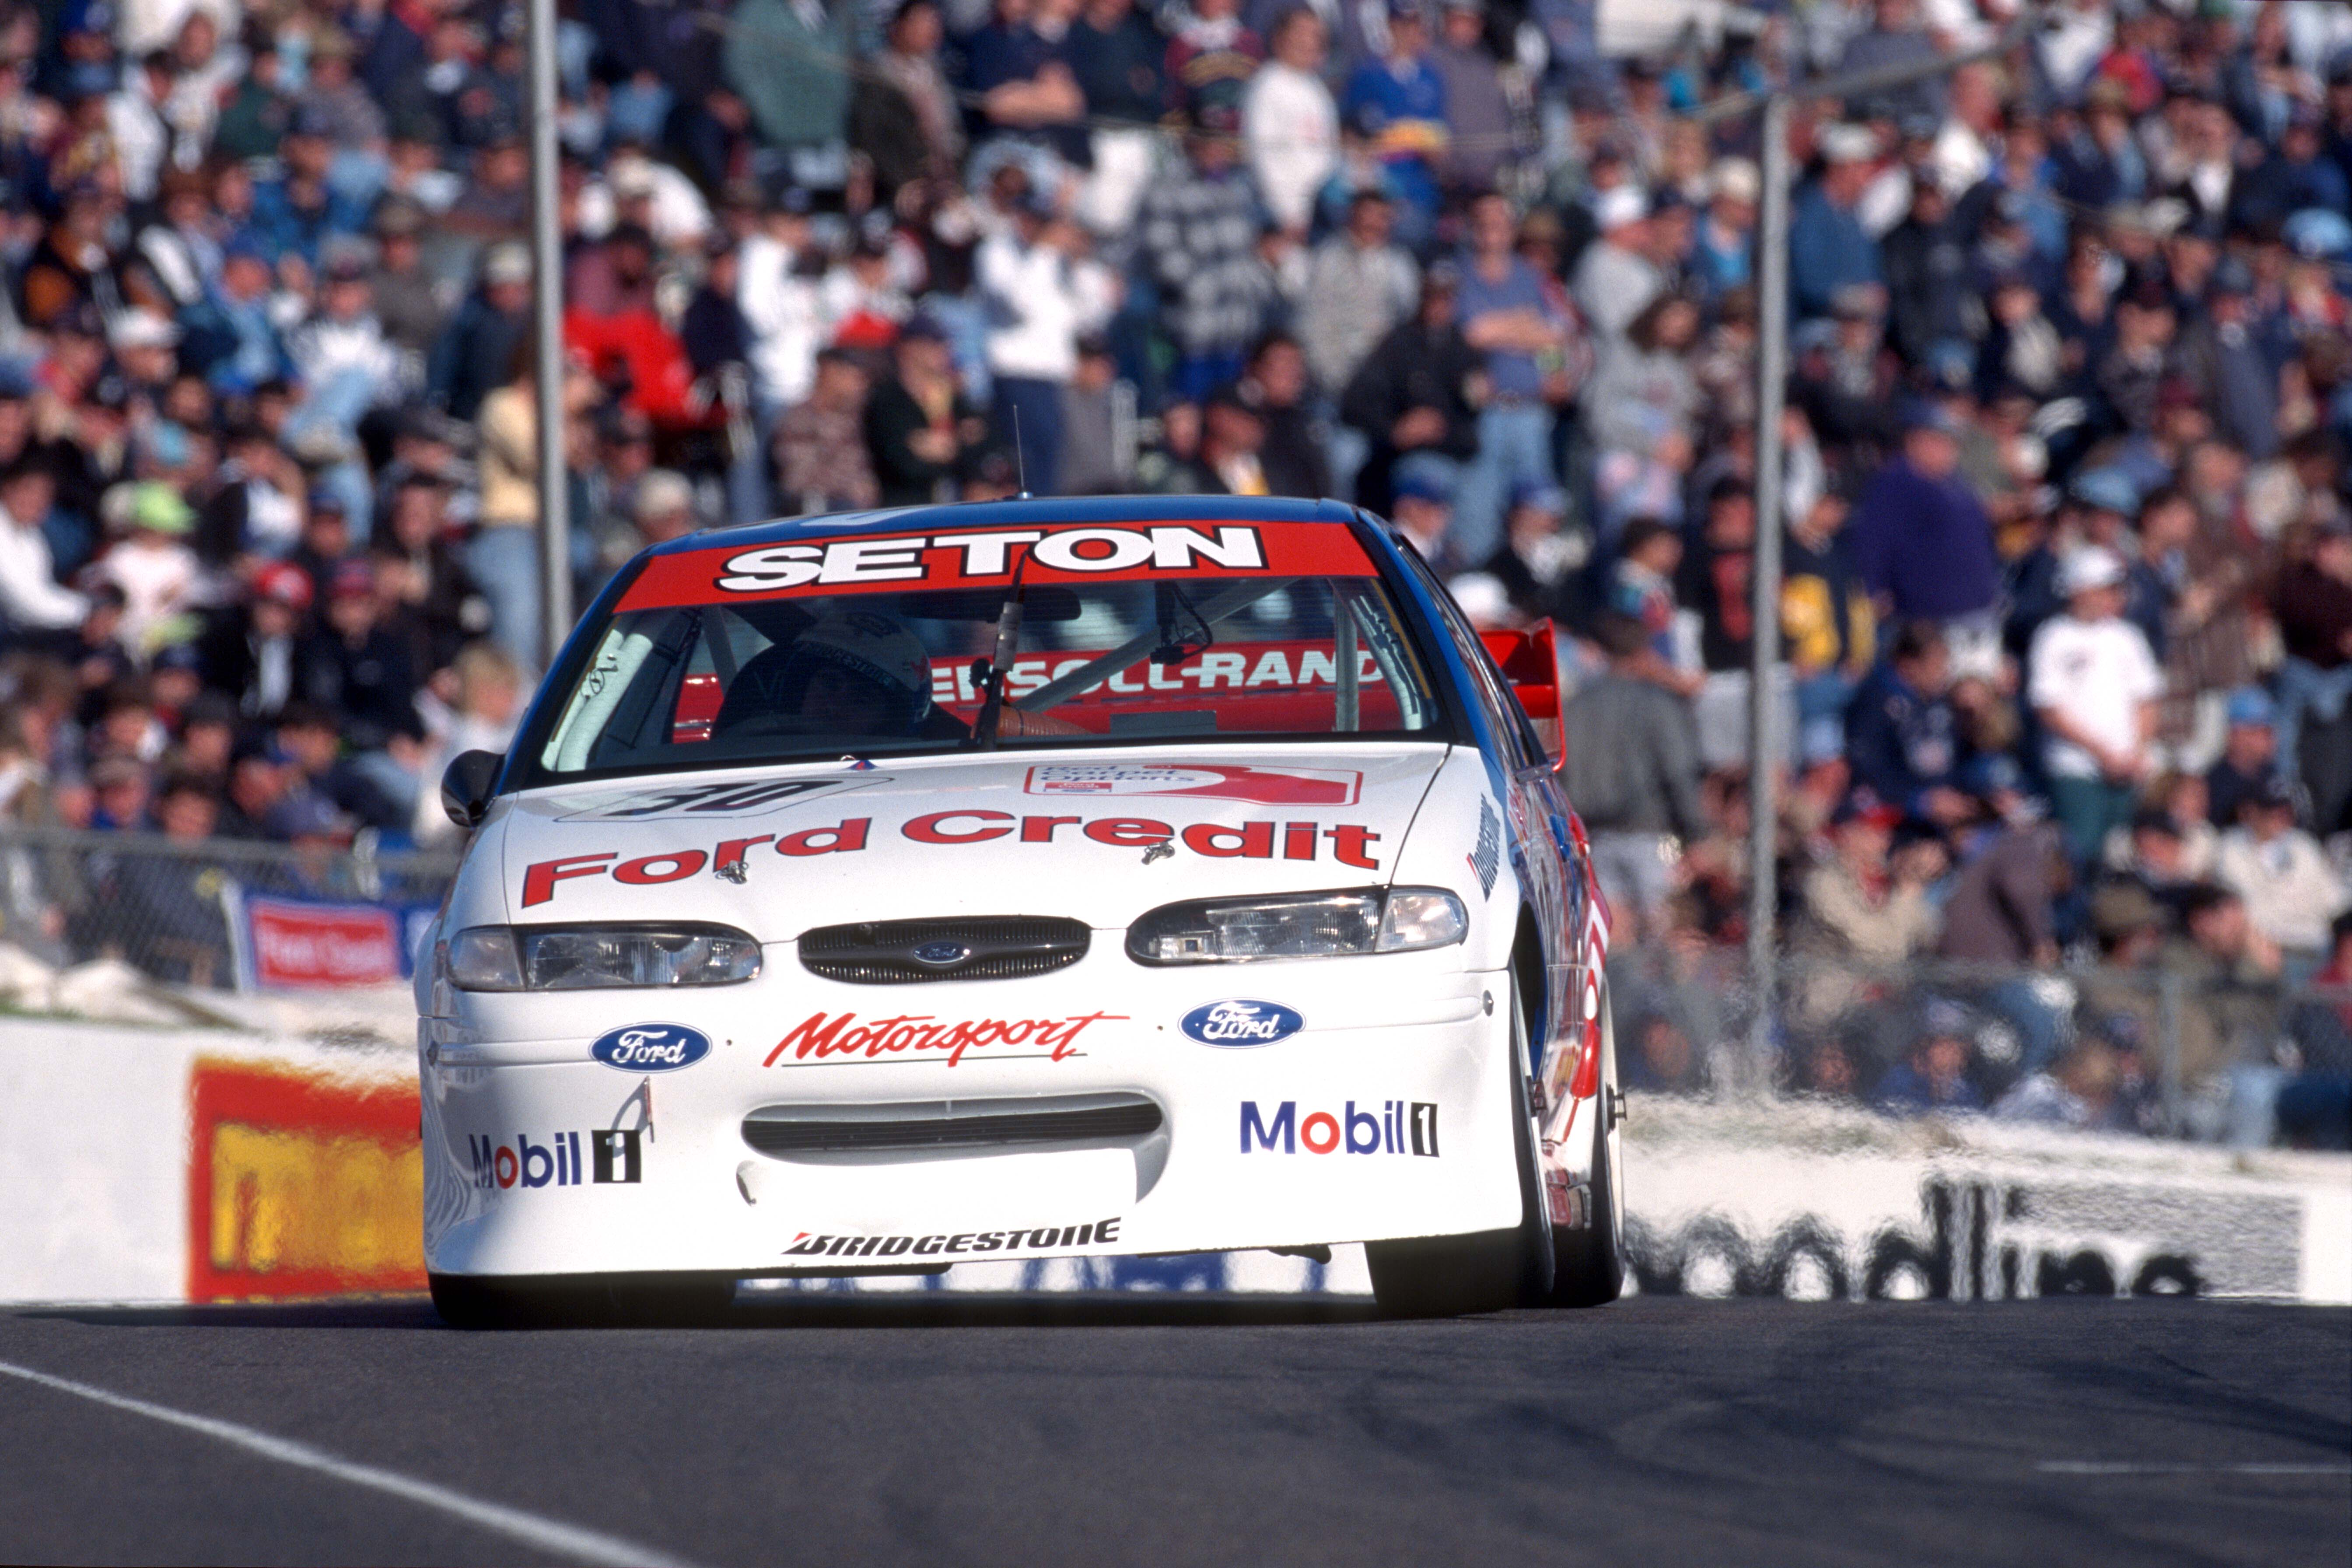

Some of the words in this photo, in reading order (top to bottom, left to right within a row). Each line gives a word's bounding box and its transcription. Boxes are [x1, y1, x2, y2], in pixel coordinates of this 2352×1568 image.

[716, 524, 1266, 592] SETON
[602, 780, 844, 816] 30
[522, 817, 872, 908] Ford
[900, 809, 1381, 870] Credit
[611, 1030, 687, 1064] Ford
[762, 1011, 1130, 1068] Motorsport
[1203, 1002, 1280, 1040] Ford
[1240, 1100, 1405, 1155] Mobil
[1414, 1103, 1435, 1156] 1
[469, 1131, 582, 1190] Mobil
[598, 1131, 633, 1182] 1
[780, 1217, 1121, 1256] BRIDGESTONE
